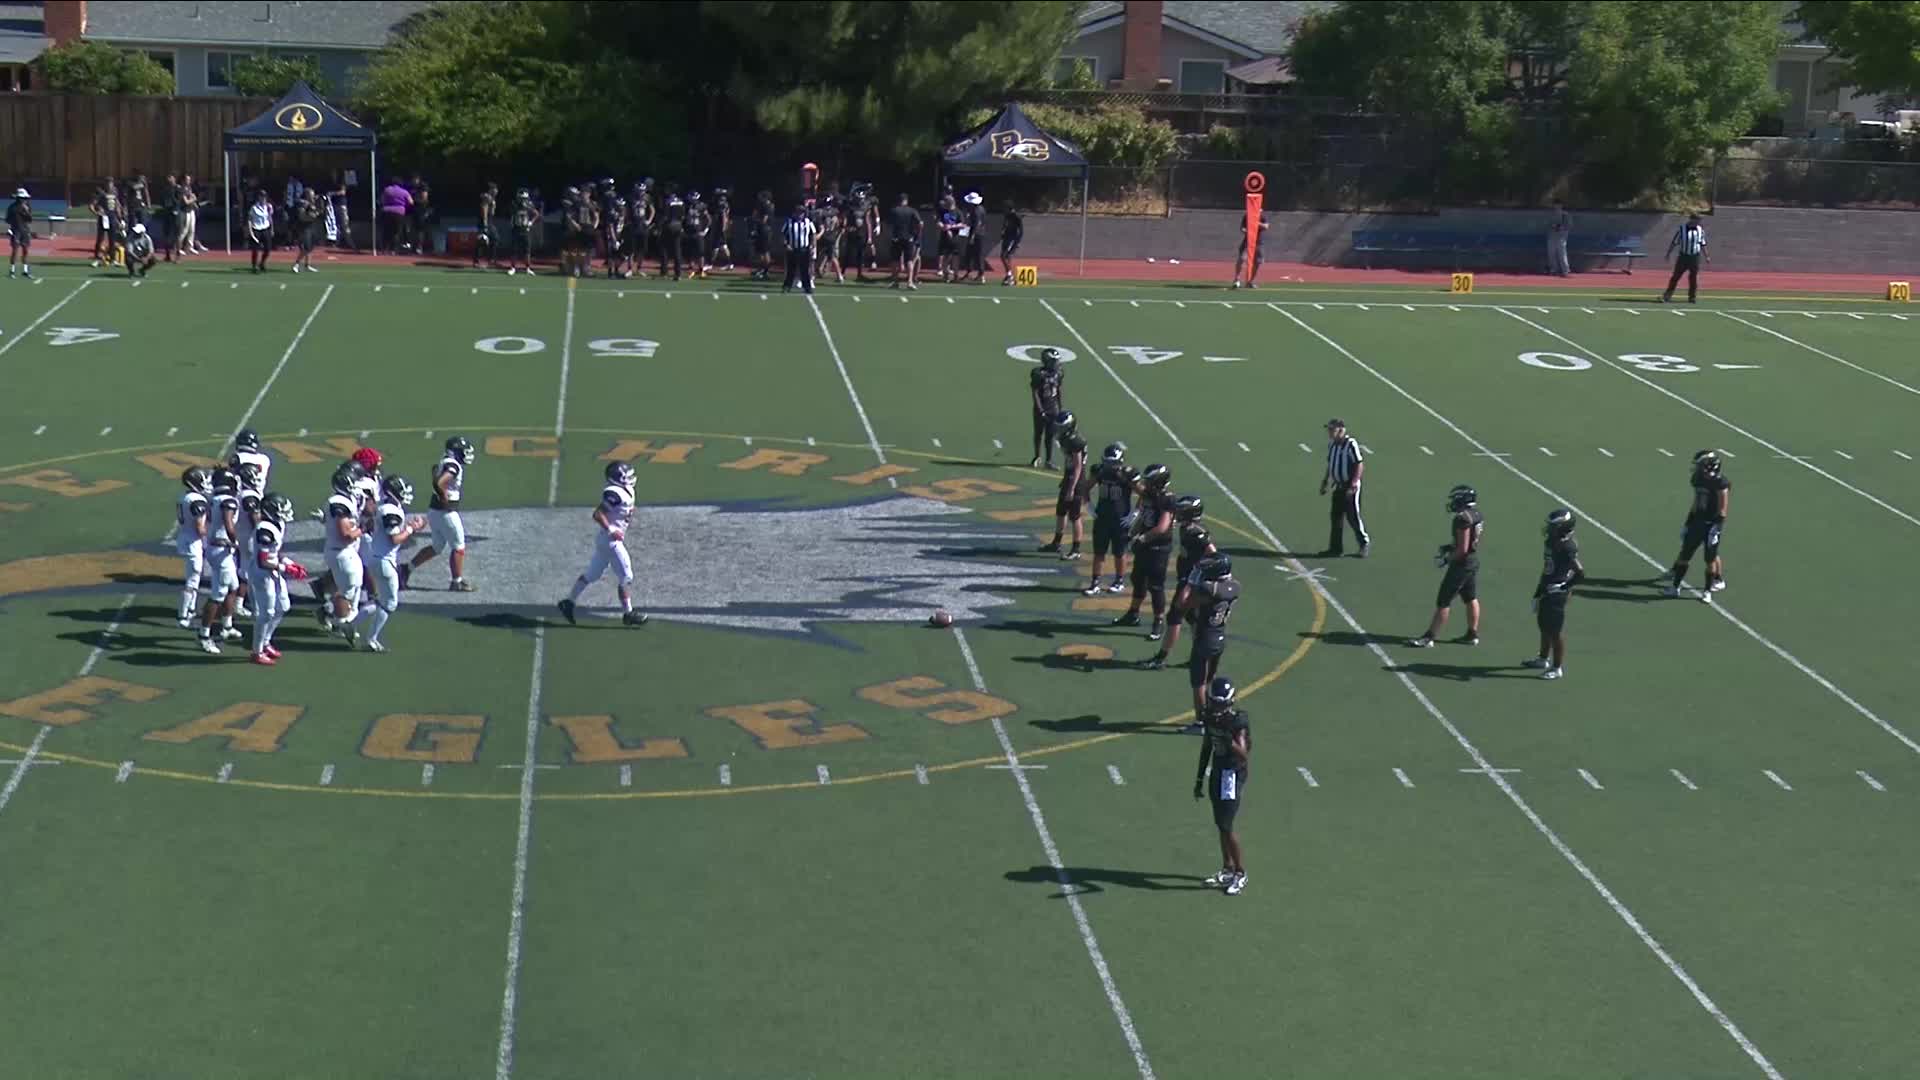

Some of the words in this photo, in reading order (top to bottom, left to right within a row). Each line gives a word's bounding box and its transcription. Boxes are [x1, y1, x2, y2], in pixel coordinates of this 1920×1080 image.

[1018, 268, 1035, 286] 40
[1454, 274, 1470, 292] 30
[1891, 283, 1908, 300] 20
[0, 674, 1018, 763] EAGLES
